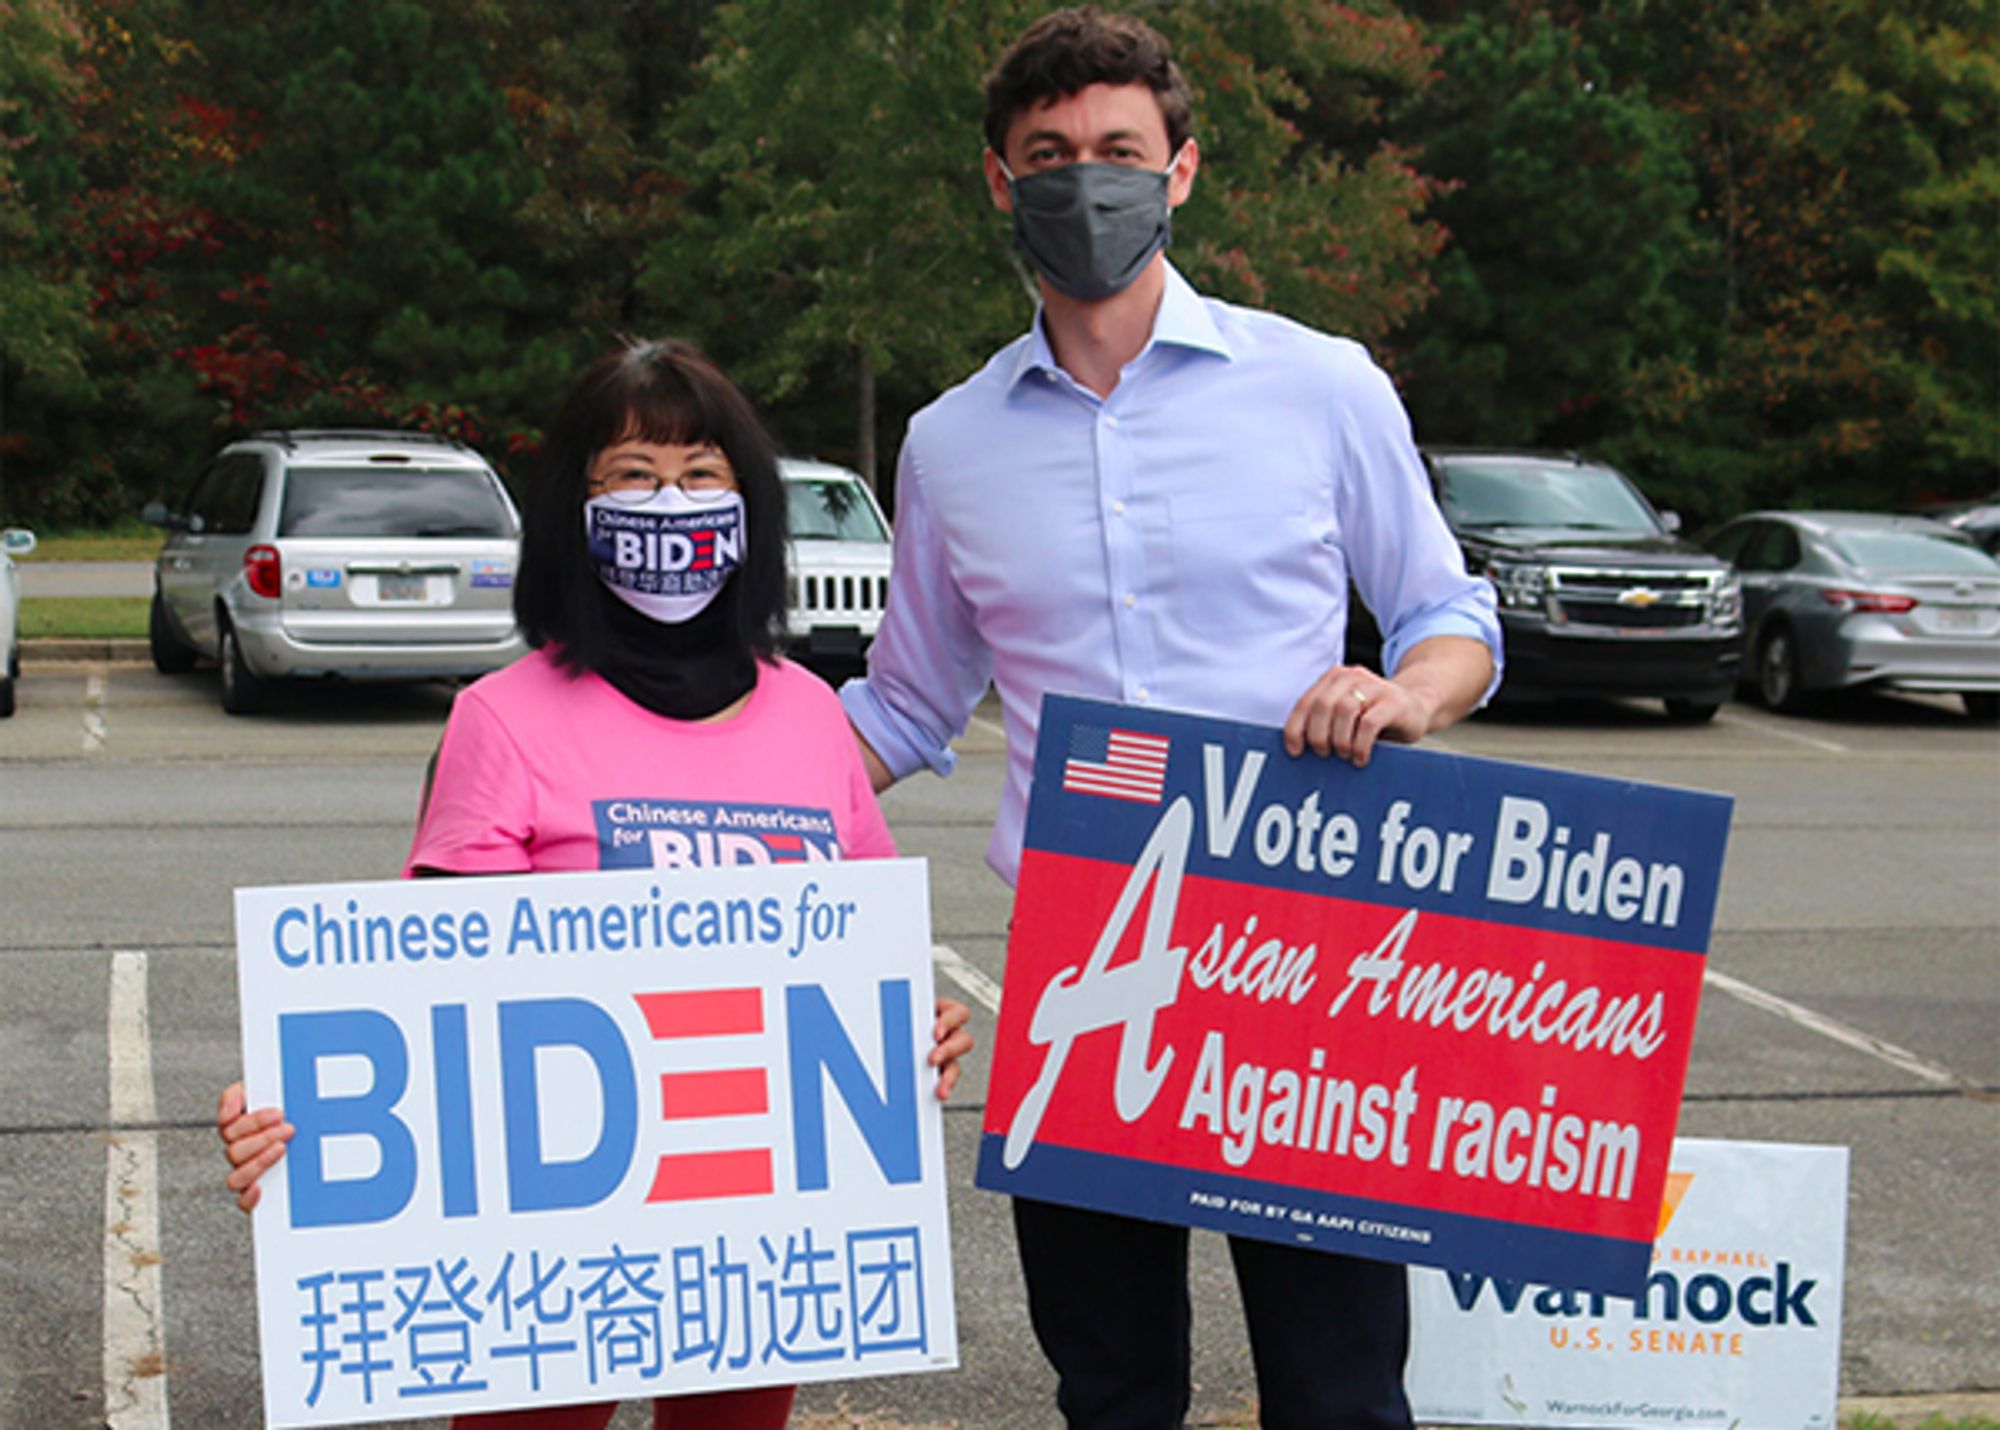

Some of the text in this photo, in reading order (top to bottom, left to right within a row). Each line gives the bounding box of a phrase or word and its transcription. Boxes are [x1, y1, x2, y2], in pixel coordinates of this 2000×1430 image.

[616, 528, 739, 571] BIDEN
[607, 803, 832, 834] Chinese Americans
[613, 827, 644, 848] for
[1202, 743, 1684, 928] Vote for Biden
[273, 883, 856, 968] Chinese Americans for
[1002, 796, 1667, 1169] Asian Americans
[278, 978, 923, 1229] BIDEN
[1179, 1030, 1640, 1200] Against racism
[1190, 1192, 1432, 1244] PAID FOR BY GA AAPI CITIZENS
[1671, 1248, 1768, 1267] RAPHAEL
[297, 1227, 929, 1408] 拜登华裔助选团
[1550, 1326, 1744, 1356] U.S. SENATE
[1546, 1400, 1726, 1421] WarnockForGeorgia.com
